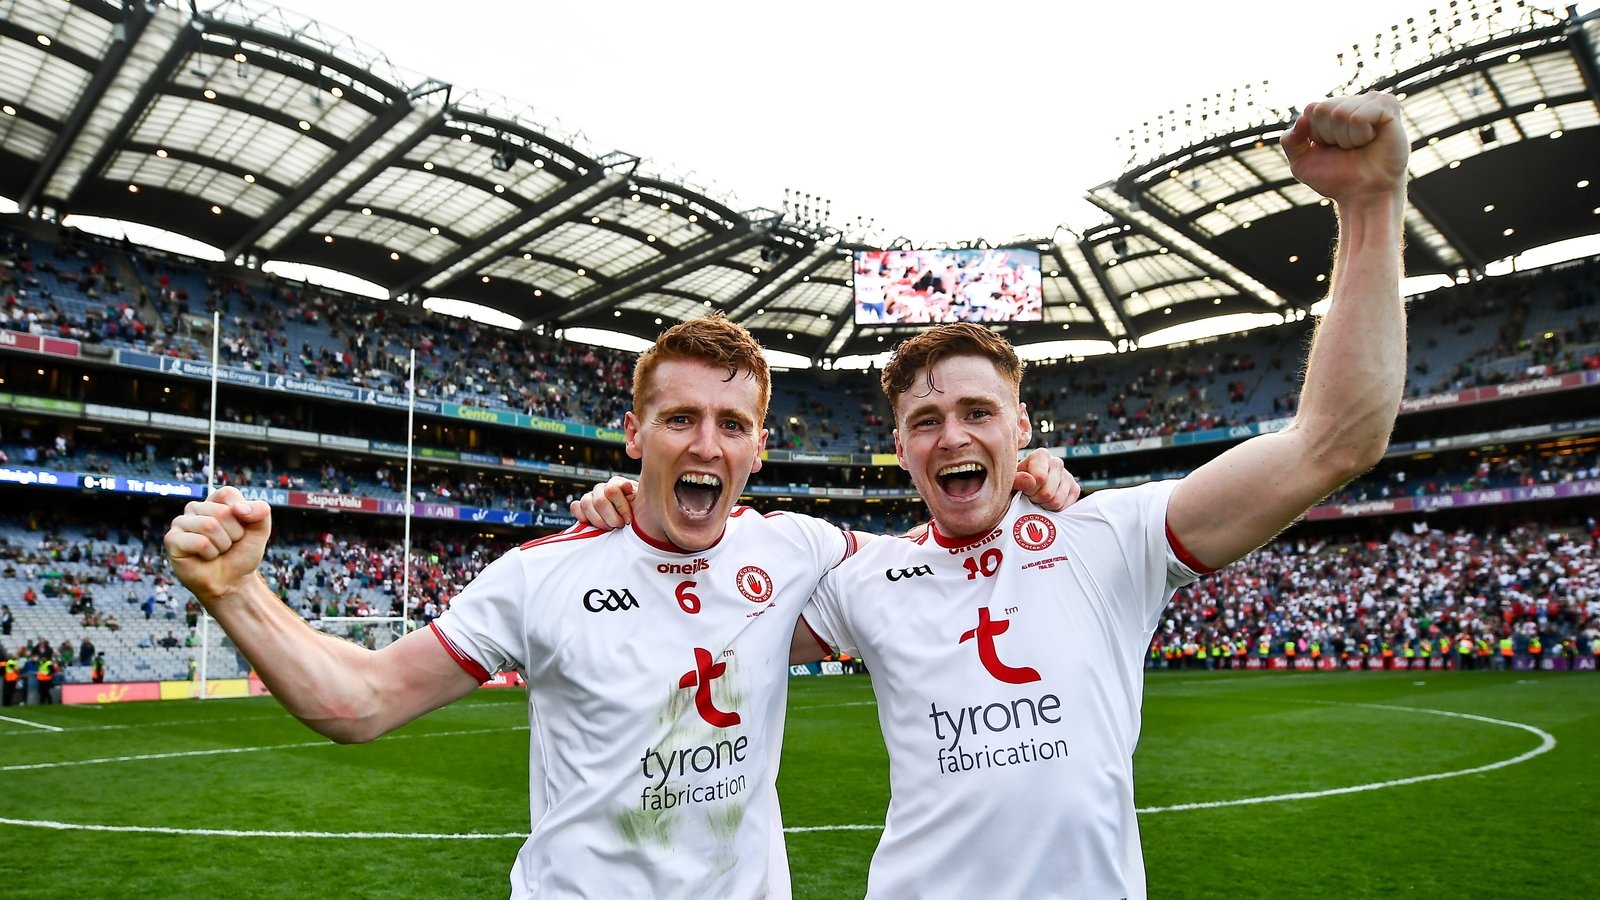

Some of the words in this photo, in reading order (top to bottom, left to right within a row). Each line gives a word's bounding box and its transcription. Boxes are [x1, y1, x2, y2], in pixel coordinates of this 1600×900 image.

[458, 405, 498, 422] Centra
[531, 417, 566, 432] Centra
[307, 492, 361, 509] SuperValu
[436, 507, 454, 518] AIB
[963, 548, 1003, 580] 10
[583, 589, 640, 612] GAA
[675, 580, 701, 614] 6
[1004, 606, 1018, 615] tm
[723, 649, 735, 658] tm
[929, 694, 1062, 752] tyrone
[640, 735, 748, 791] tyrone
[937, 738, 1068, 774] fabrication
[641, 774, 746, 811] fabrication
